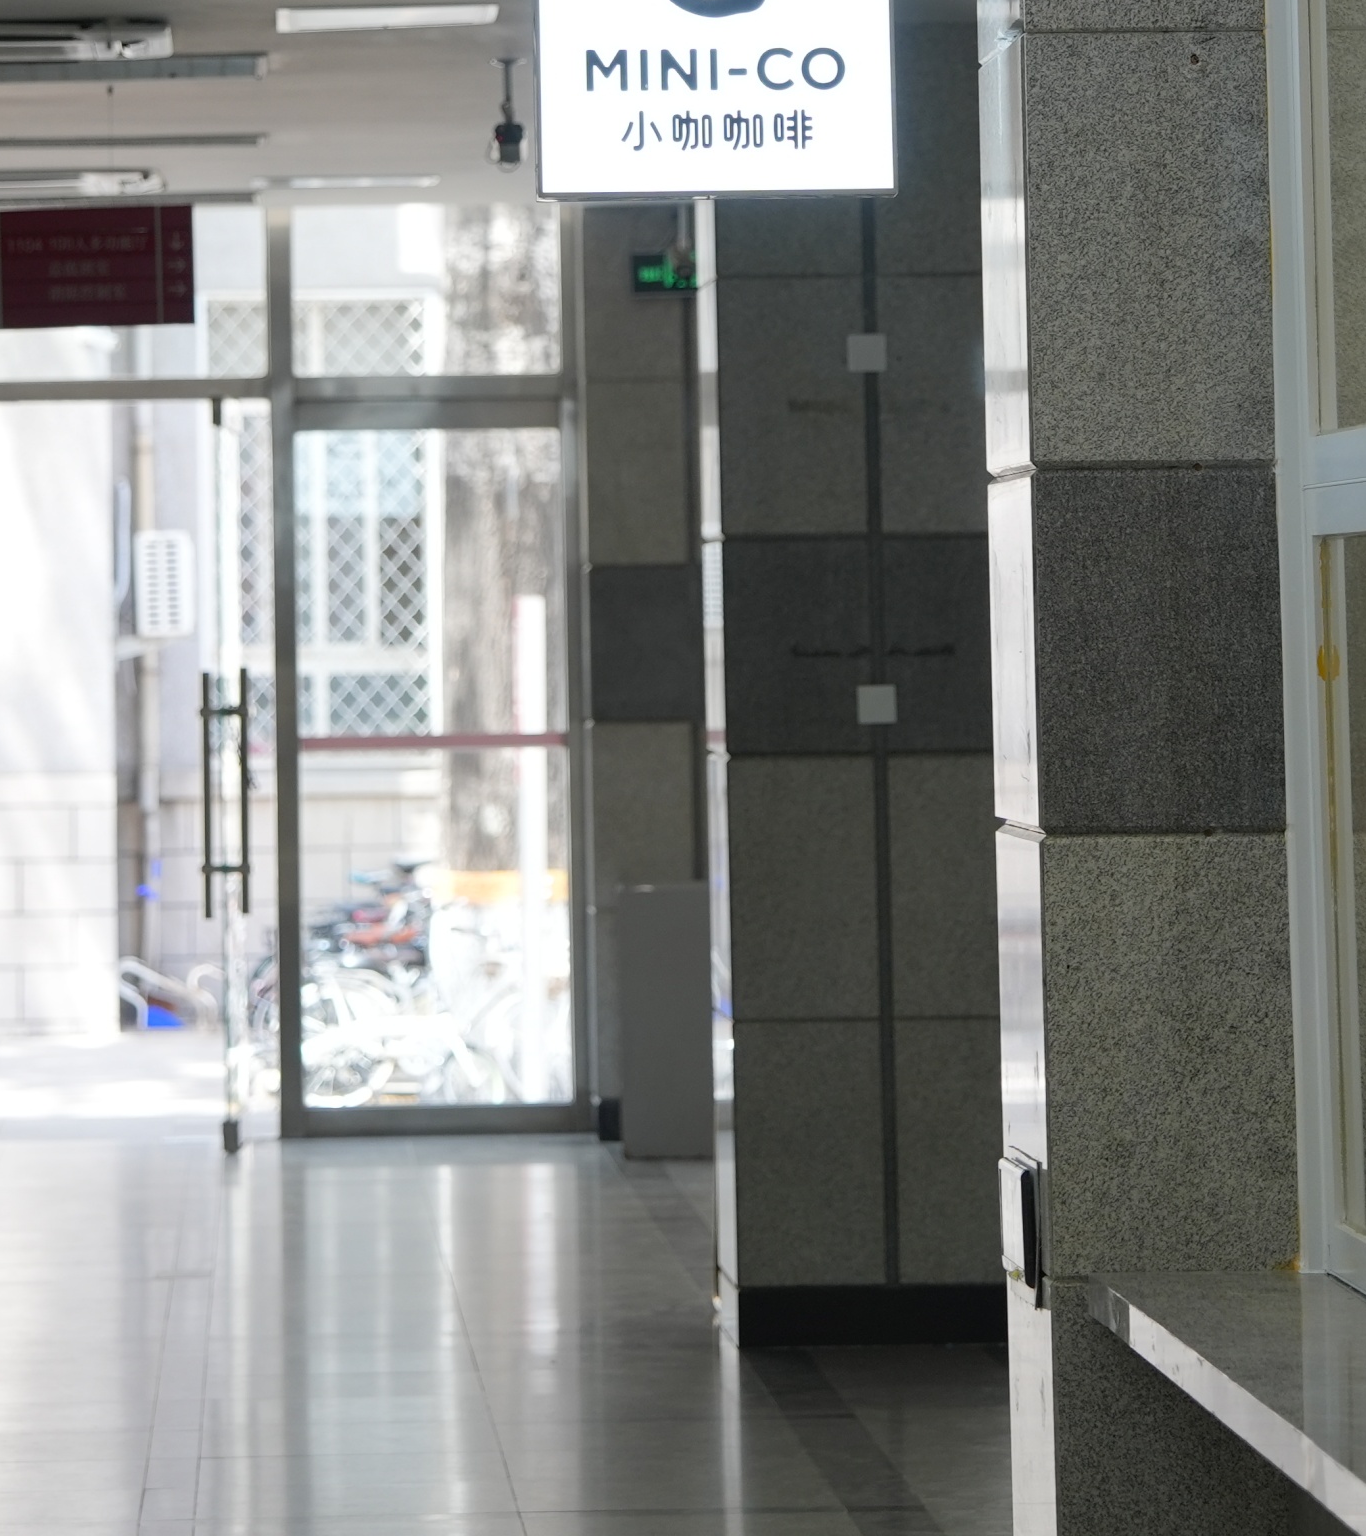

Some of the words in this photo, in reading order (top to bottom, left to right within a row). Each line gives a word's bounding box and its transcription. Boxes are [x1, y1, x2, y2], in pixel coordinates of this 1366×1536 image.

[586, 47, 846, 92] MINI-CO
[621, 109, 813, 151] 小咖咖啡
